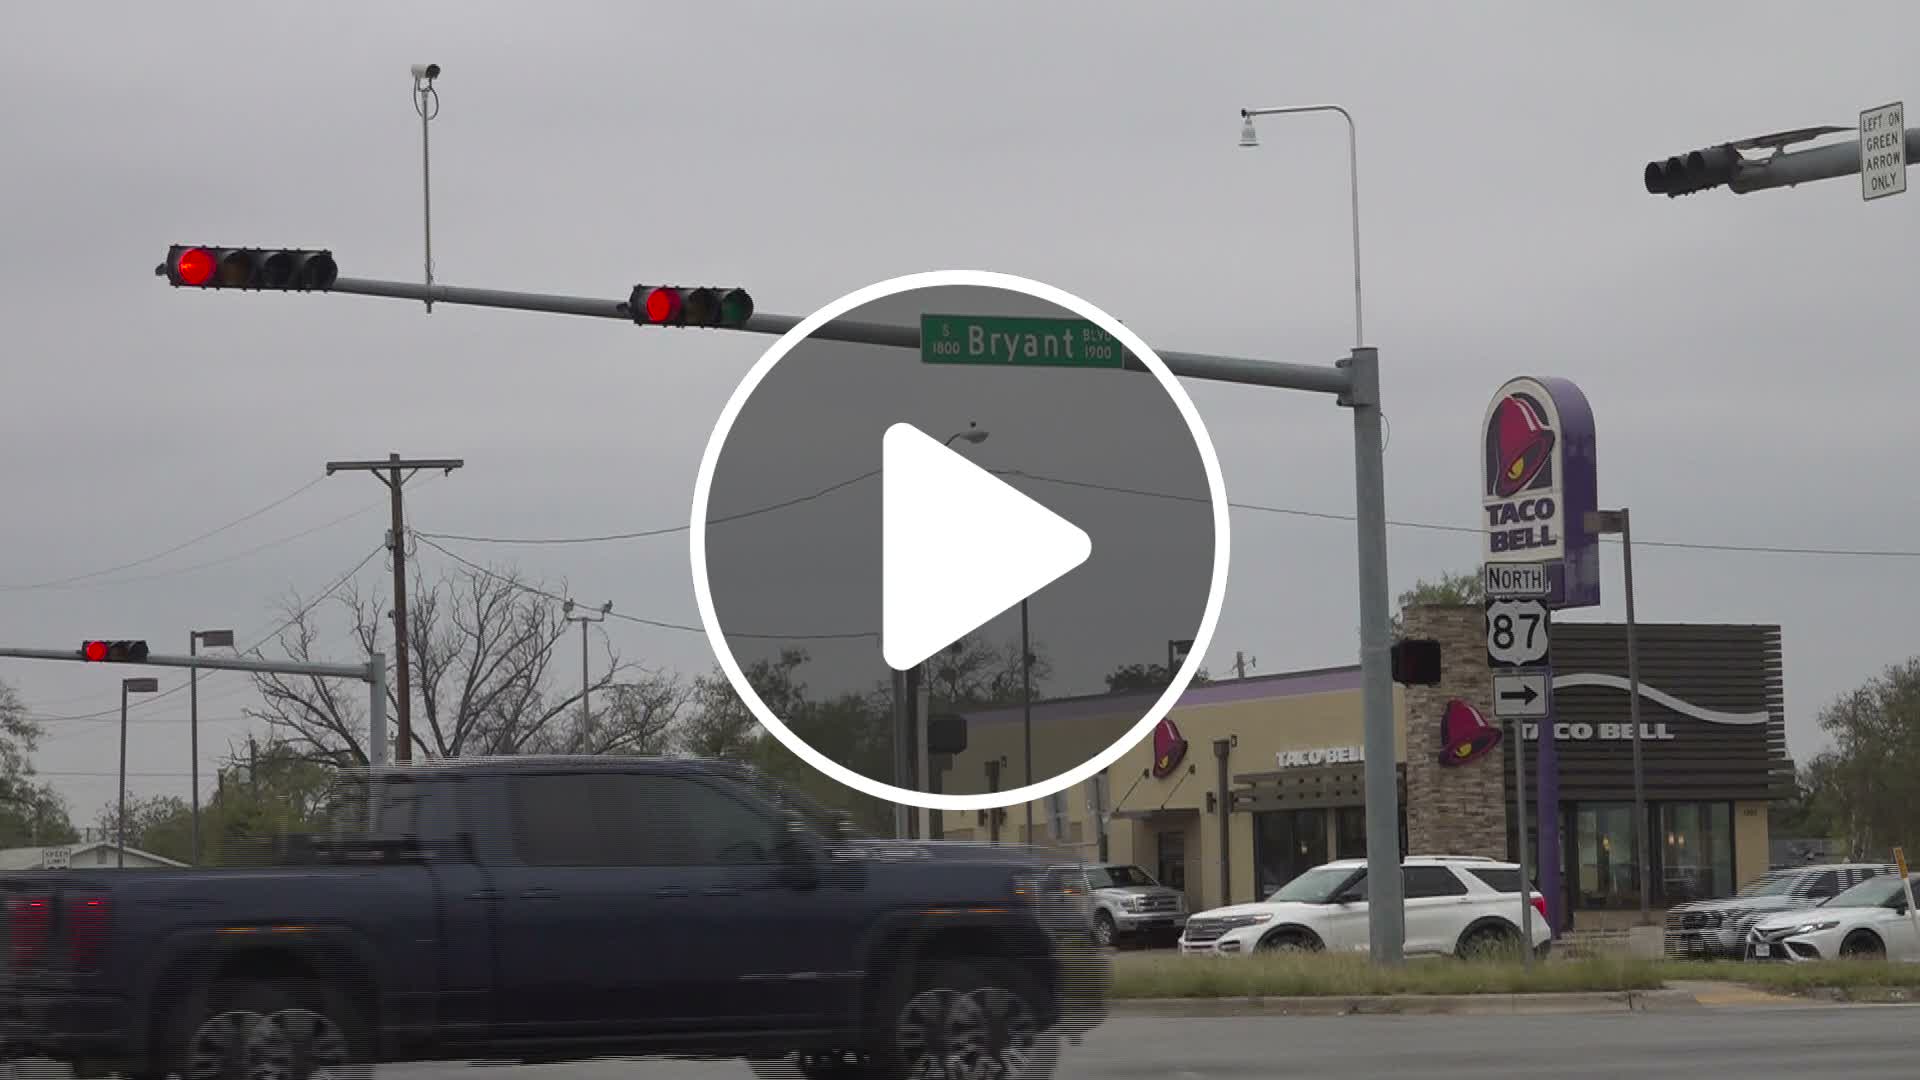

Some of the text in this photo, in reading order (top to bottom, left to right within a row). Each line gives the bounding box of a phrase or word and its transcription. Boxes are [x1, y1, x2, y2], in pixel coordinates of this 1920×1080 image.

[1863, 112, 1900, 132] LEFT ON
[1866, 132, 1898, 152] GREEN
[1866, 152, 1900, 172] ARROW
[1871, 172, 1897, 190] ONLY
[933, 341, 960, 355] 1800
[943, 324, 1112, 361] S Bryant BLVD
[1085, 345, 1112, 359] 1900
[1484, 498, 1555, 526] TACO
[1490, 525, 1557, 552] BELL
[1489, 567, 1541, 589] NORTH
[1493, 613, 1540, 649] 87
[1598, 723, 1675, 739] BELL
[1276, 751, 1321, 767] TACO
